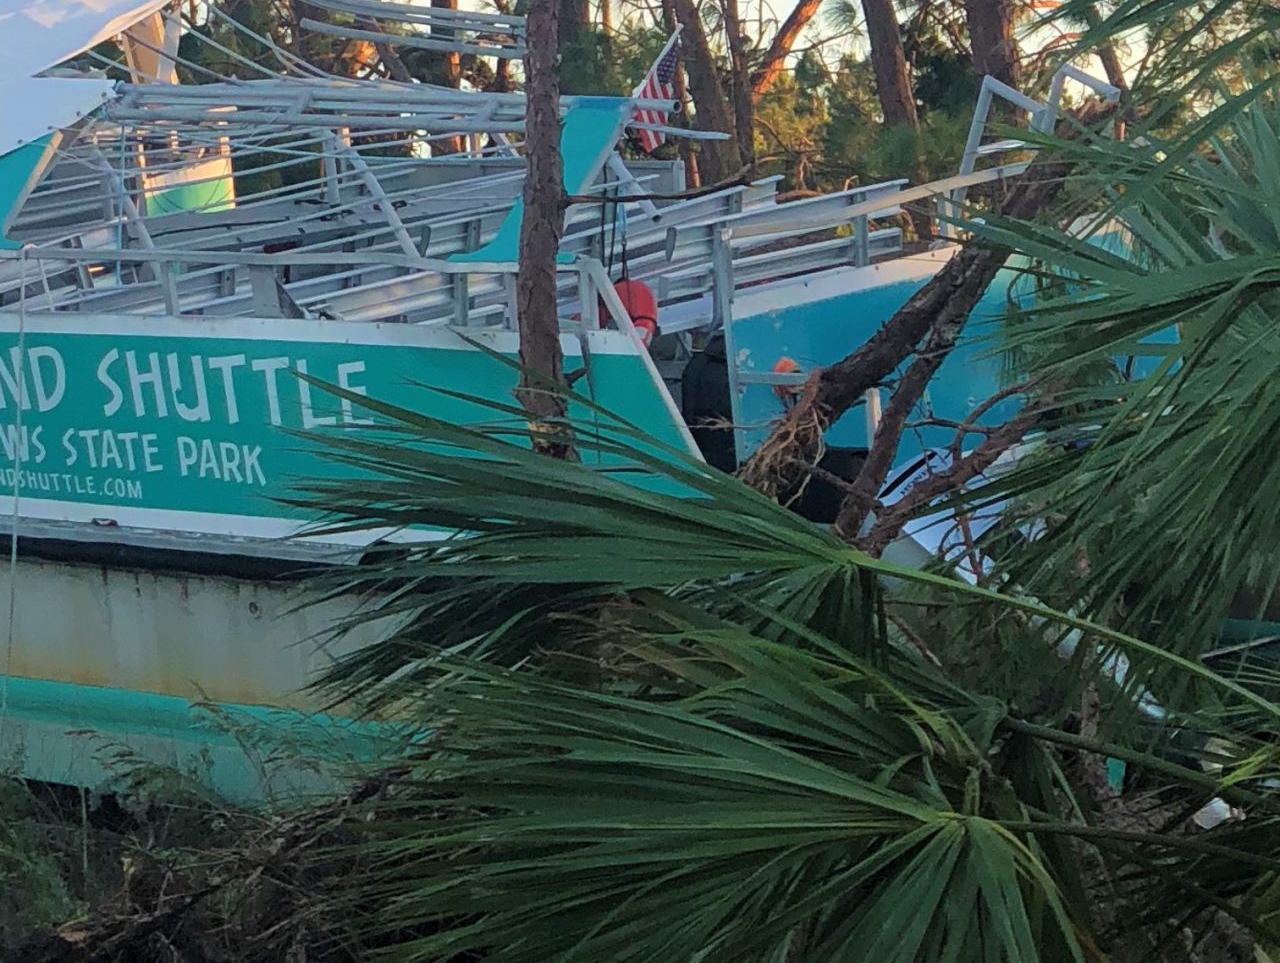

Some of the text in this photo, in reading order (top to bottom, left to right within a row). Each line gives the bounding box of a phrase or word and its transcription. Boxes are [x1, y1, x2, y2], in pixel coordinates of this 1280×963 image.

[97, 348, 373, 430] SHUTTLE
[62, 428, 163, 472] STATE
[177, 437, 267, 486] PARK
